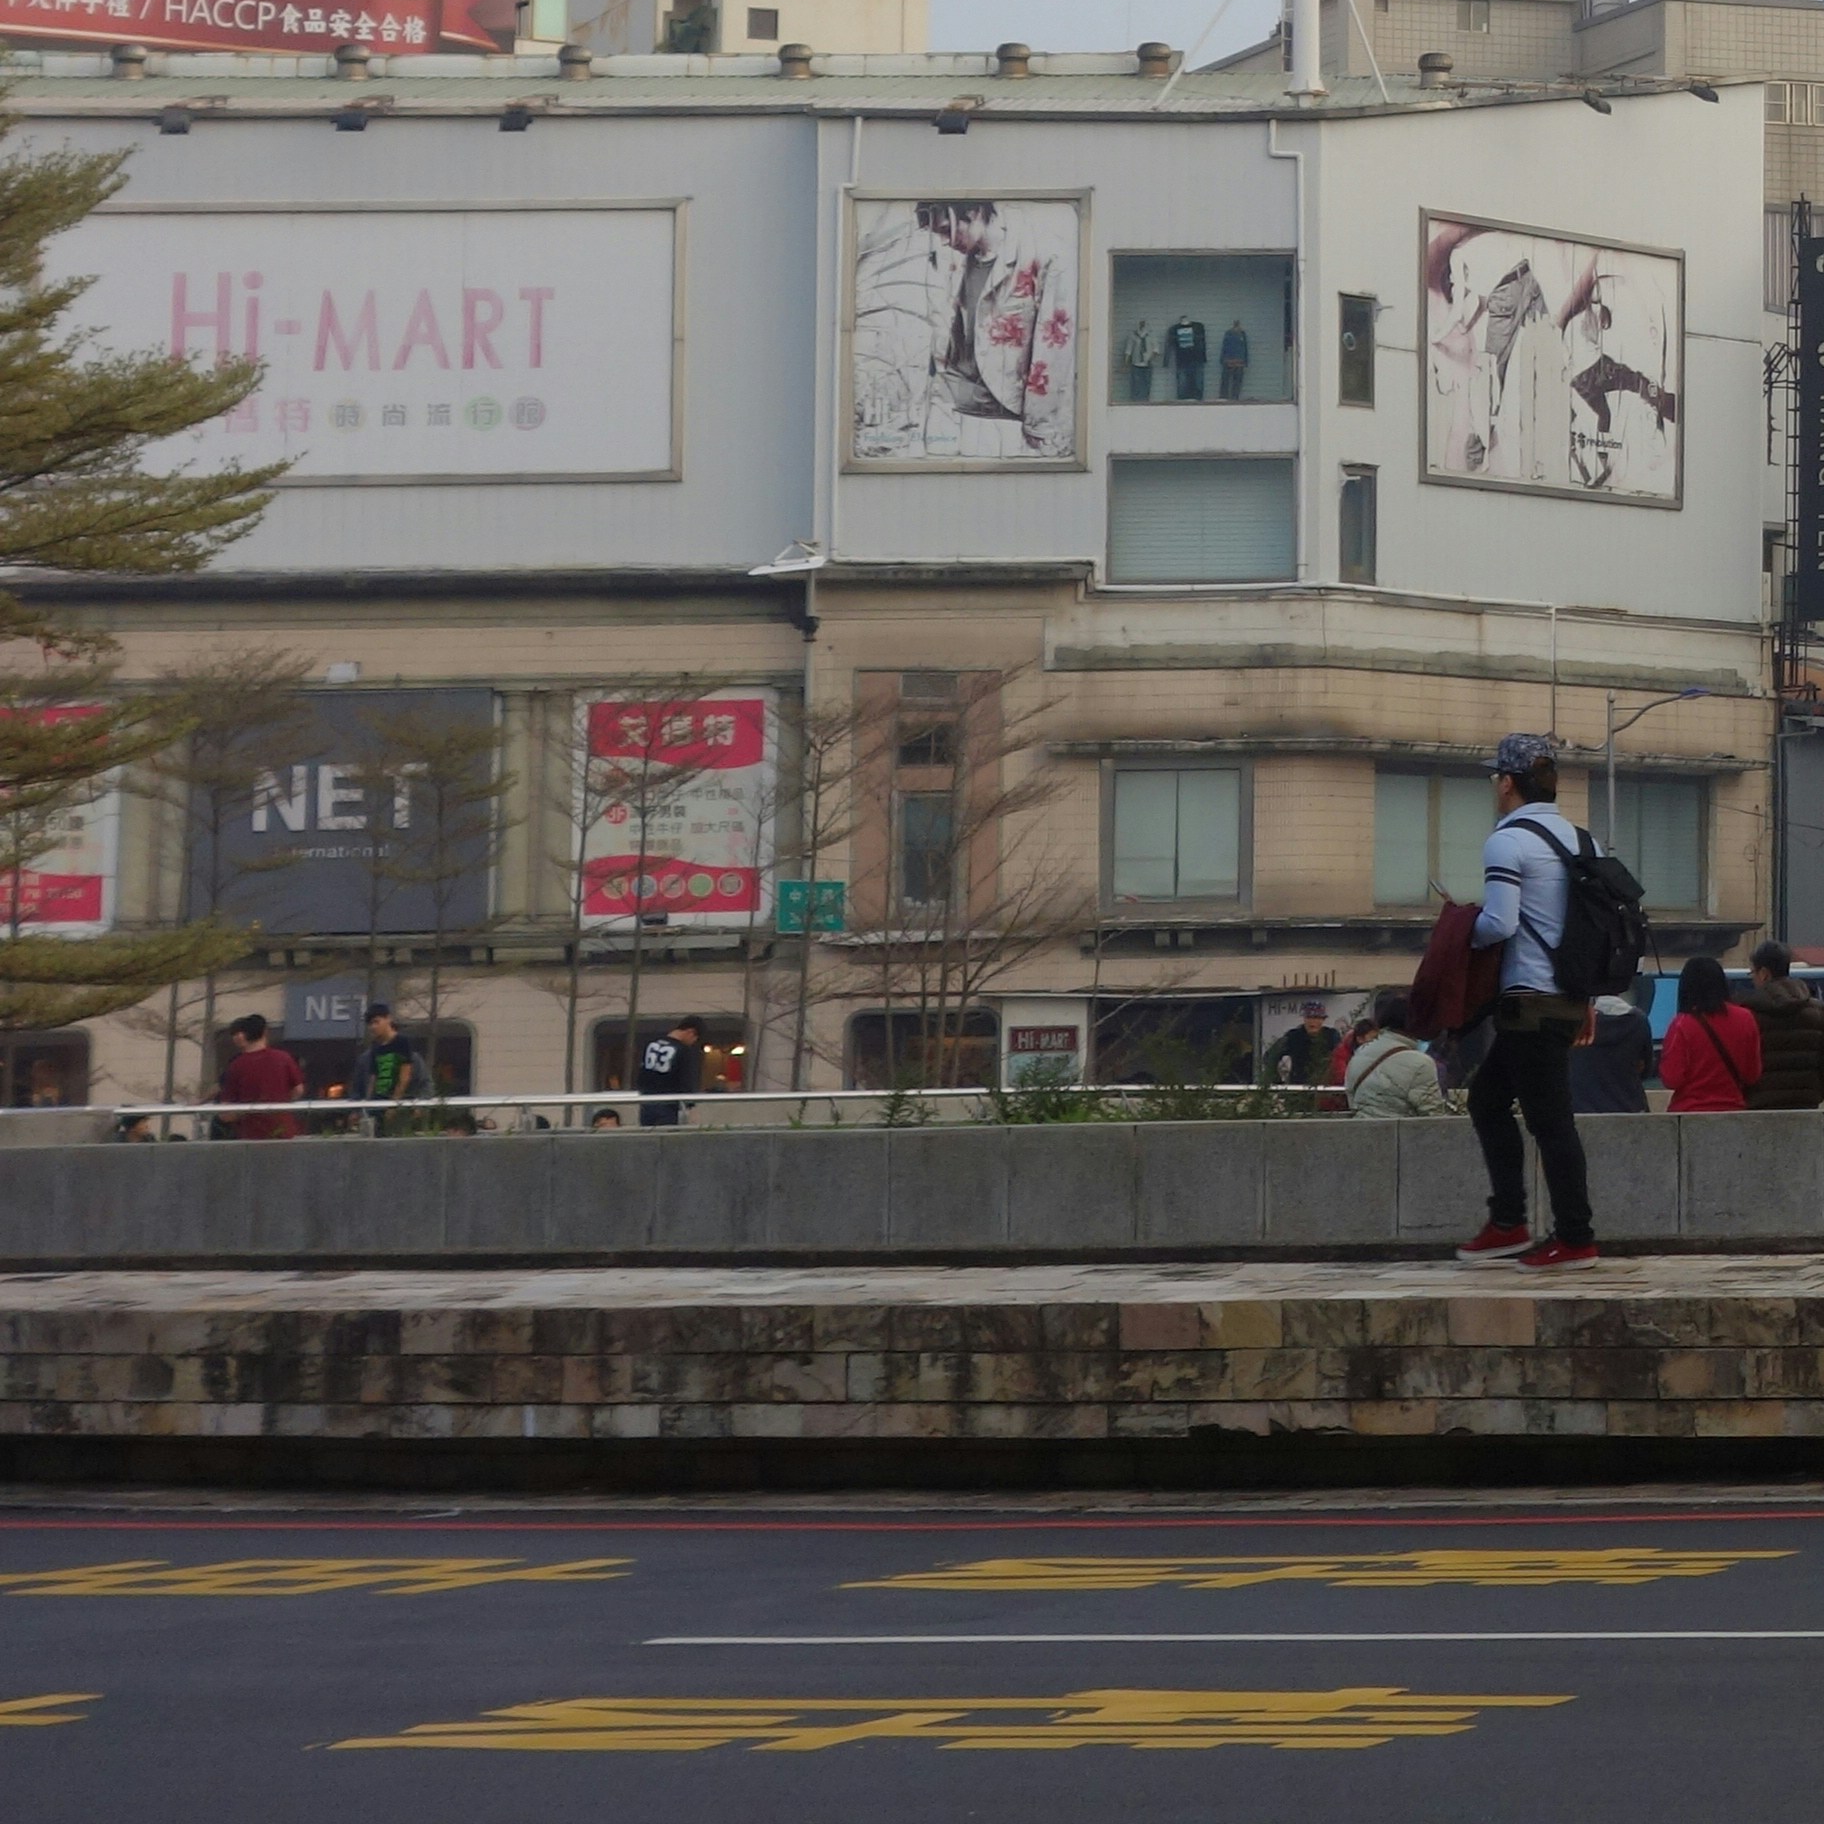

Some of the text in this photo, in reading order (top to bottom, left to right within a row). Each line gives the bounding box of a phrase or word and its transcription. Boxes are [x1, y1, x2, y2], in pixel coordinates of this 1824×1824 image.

[170, 270, 556, 373] Hi-MART
[252, 762, 429, 832] NET
[305, 994, 369, 1022] NET
[645, 1041, 676, 1073] 63
